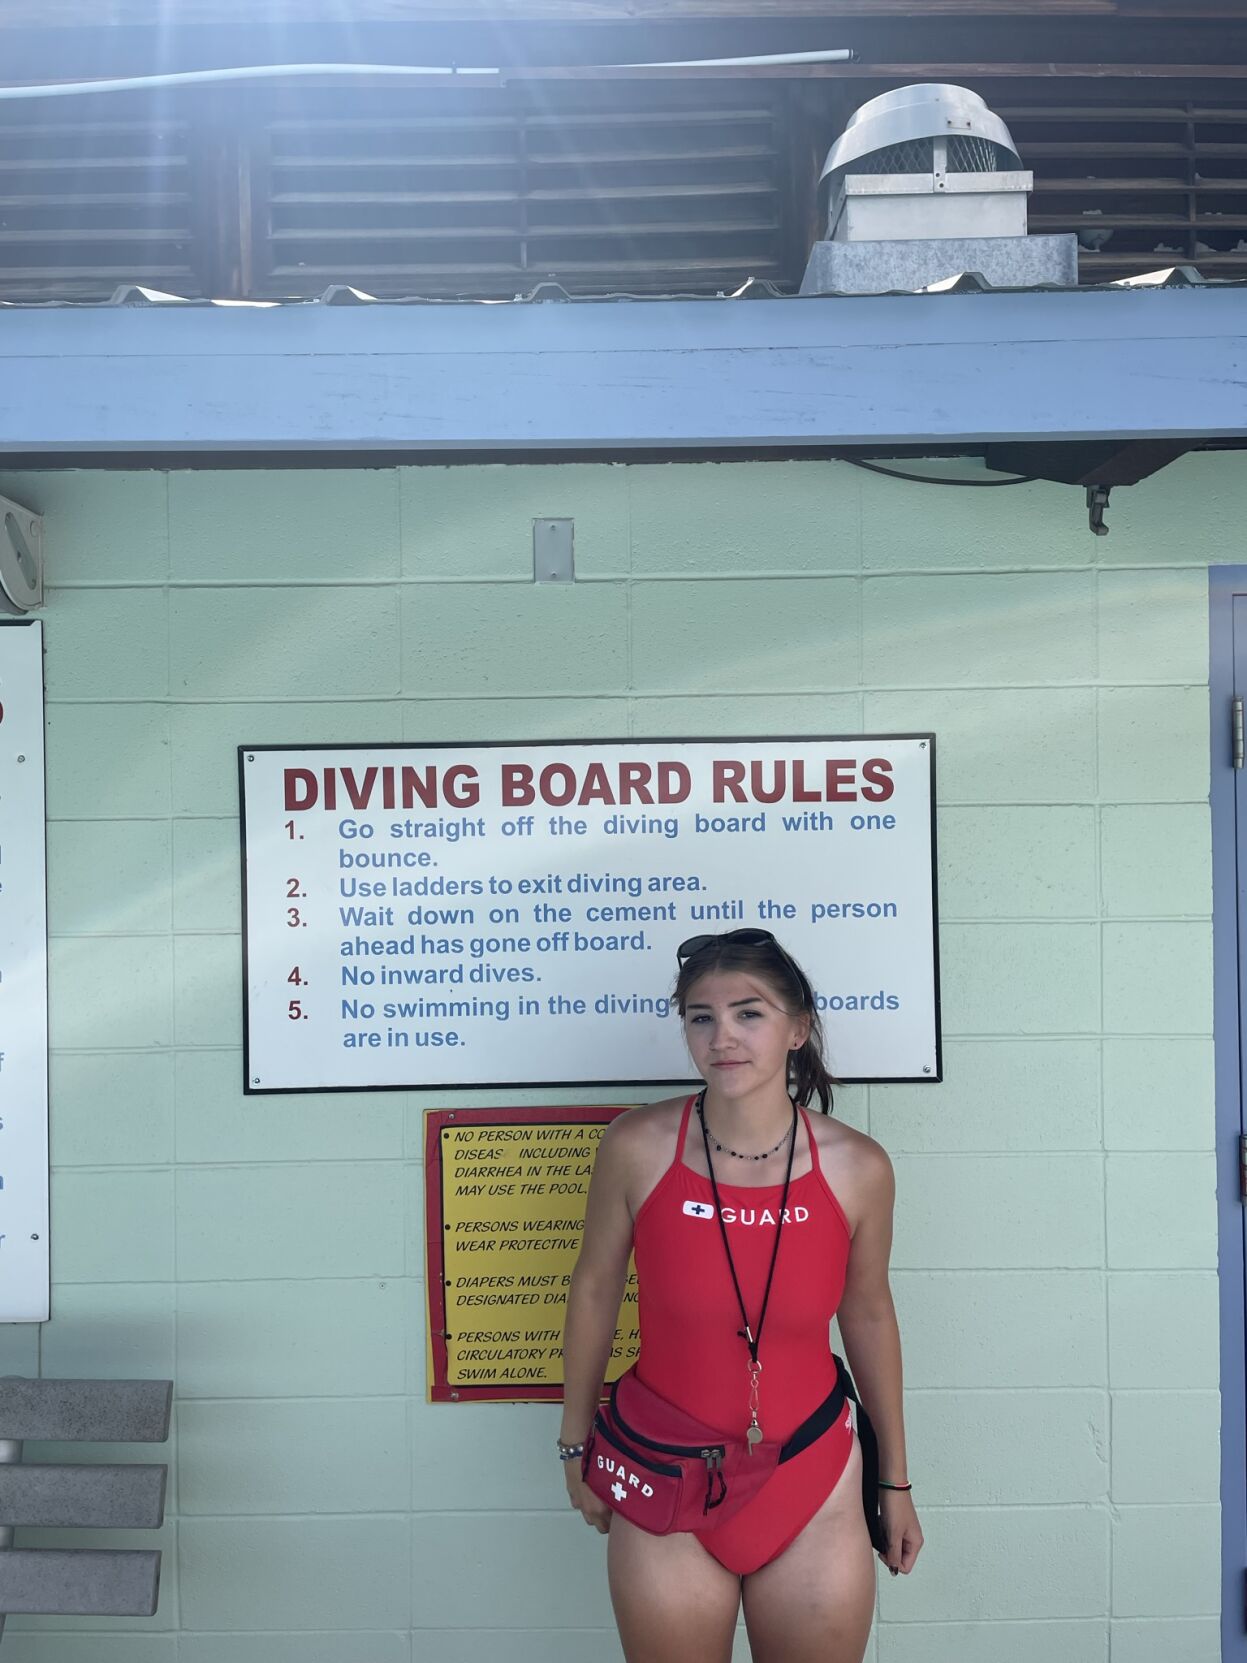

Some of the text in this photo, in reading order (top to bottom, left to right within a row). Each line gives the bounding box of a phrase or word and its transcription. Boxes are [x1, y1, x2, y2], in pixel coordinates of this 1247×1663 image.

[284, 758, 894, 811] DIVING BOARD RULES
[285, 811, 896, 842] 1. Go straight off the diving board with one
[340, 849, 437, 868] bounce.
[287, 874, 707, 898] 2. Use ladders to exit diving area.
[287, 900, 897, 927] 3. Wait down on the cement until the person
[340, 931, 652, 958] ahead has gone off board.
[288, 964, 541, 985] 4. No inward dives.
[288, 991, 899, 1020] 5. No swimming in the diving boards
[343, 1029, 465, 1047] are in use.
[455, 1131, 474, 1142] NO
[478, 1130, 532, 1141] PERSON
[536, 1130, 570, 1140] WITH
[574, 1129, 584, 1139] A
[455, 1149, 505, 1160] DISEAS
[519, 1147, 590, 1158] INCLUDING
[455, 1165, 593, 1178] DIARRHEA IN THE LA
[455, 1183, 587, 1196] MAY USE THE POOL.
[721, 1206, 808, 1225] GUARD
[455, 1220, 584, 1232] PERSONS WEARING
[456, 1239, 579, 1251] WEAR PROTECTIVE
[456, 1275, 571, 1287] DIAPERS MUST B
[457, 1293, 568, 1305] DESIGNATED DIA
[457, 1330, 560, 1342] PERSONS WITH
[457, 1349, 547, 1360] CIRCULATORY
[457, 1367, 547, 1380] SWIM ALONE.
[598, 1456, 653, 1497] GUARD
